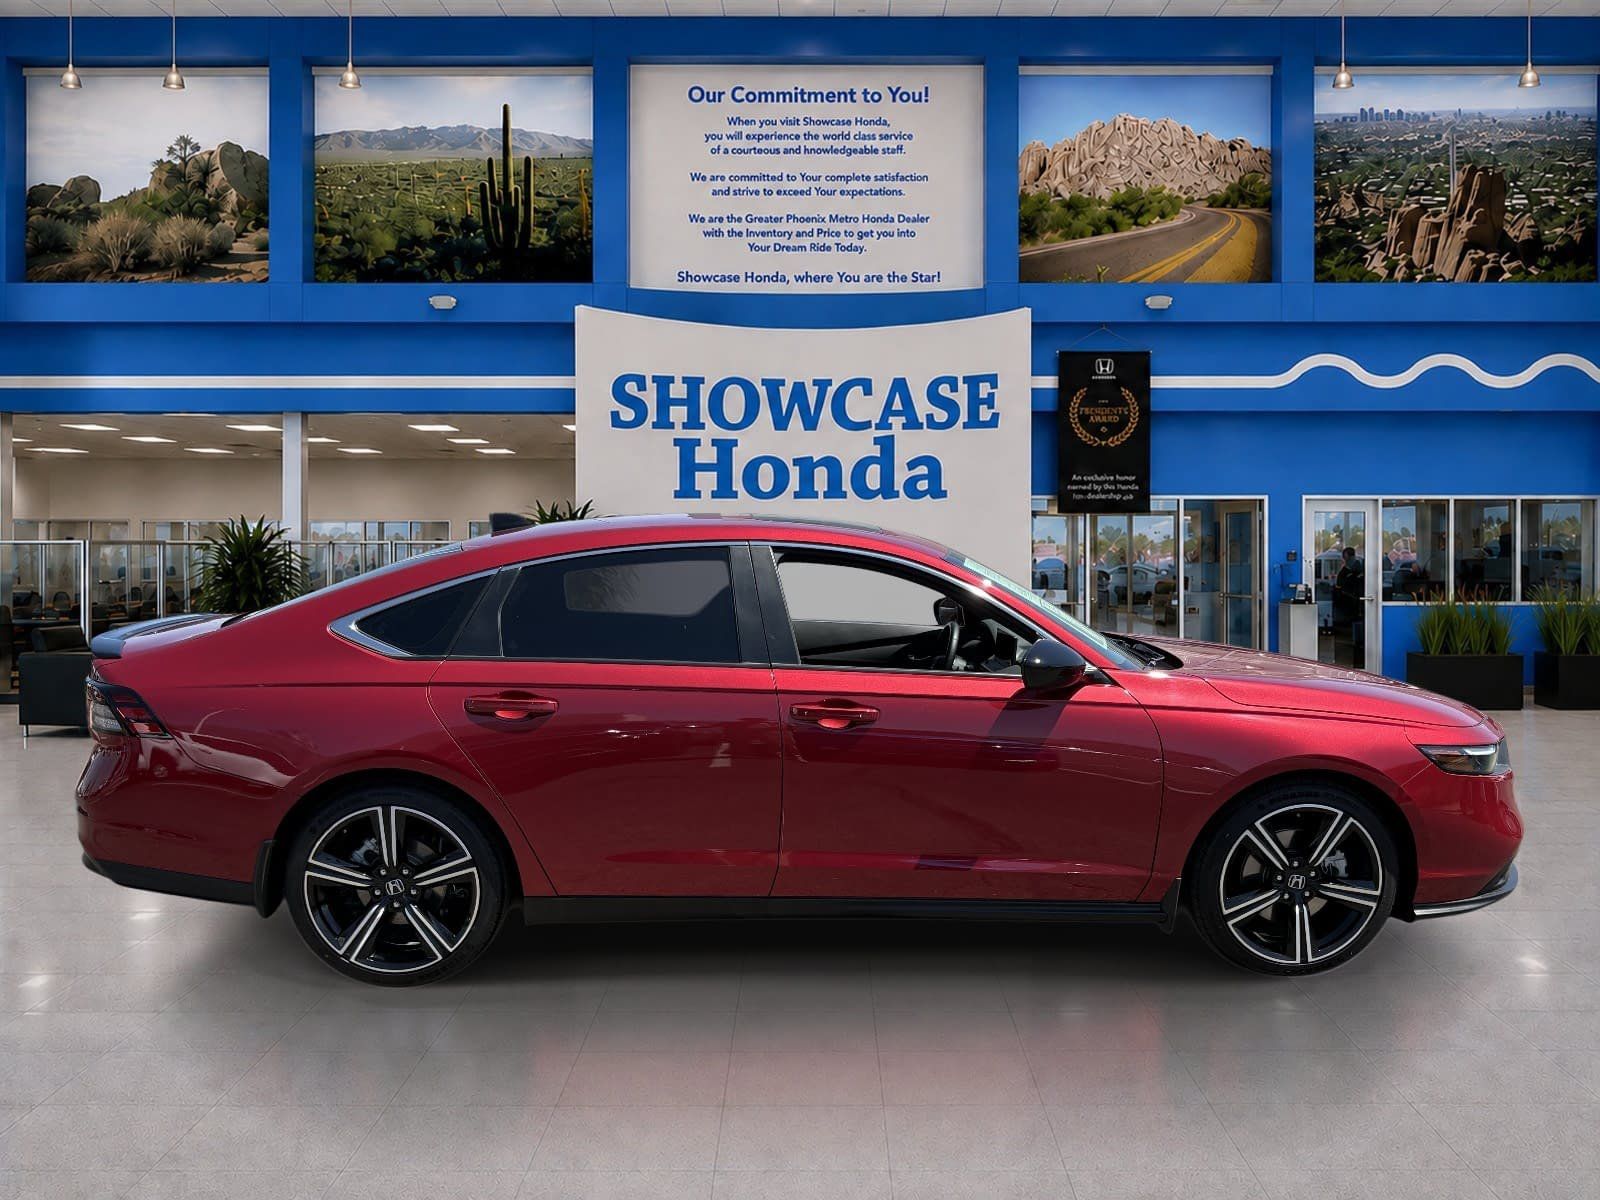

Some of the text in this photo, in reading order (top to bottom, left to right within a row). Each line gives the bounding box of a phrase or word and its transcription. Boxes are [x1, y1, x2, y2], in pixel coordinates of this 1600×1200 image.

[688, 85, 929, 103] Our Commitment to You!
[727, 116, 890, 128] When you visit Showcase Honda,
[705, 131, 913, 143] you will experience the world class service
[710, 145, 721, 154] of
[731, 147, 781, 155] courteous
[783, 145, 801, 155] and
[882, 144, 906, 155] staff.
[690, 172, 707, 182] We
[728, 172, 783, 182] committed
[786, 174, 797, 182] to
[800, 172, 822, 182] Your
[825, 172, 871, 185] complete
[874, 172, 928, 182] satisfaction
[712, 186, 905, 199] and strive to exceed Your expectations.
[688, 213, 930, 224] We are the Greater Phoenix Metro Honda Dealer
[703, 228, 916, 240] with the Inventory and Price to get you into
[748, 242, 867, 254] Your Dream Ride Today.
[677, 271, 941, 285] Showcase Honda, where You are the Star!
[611, 373, 1000, 431] SHOWCASE
[673, 435, 947, 500] Honda
